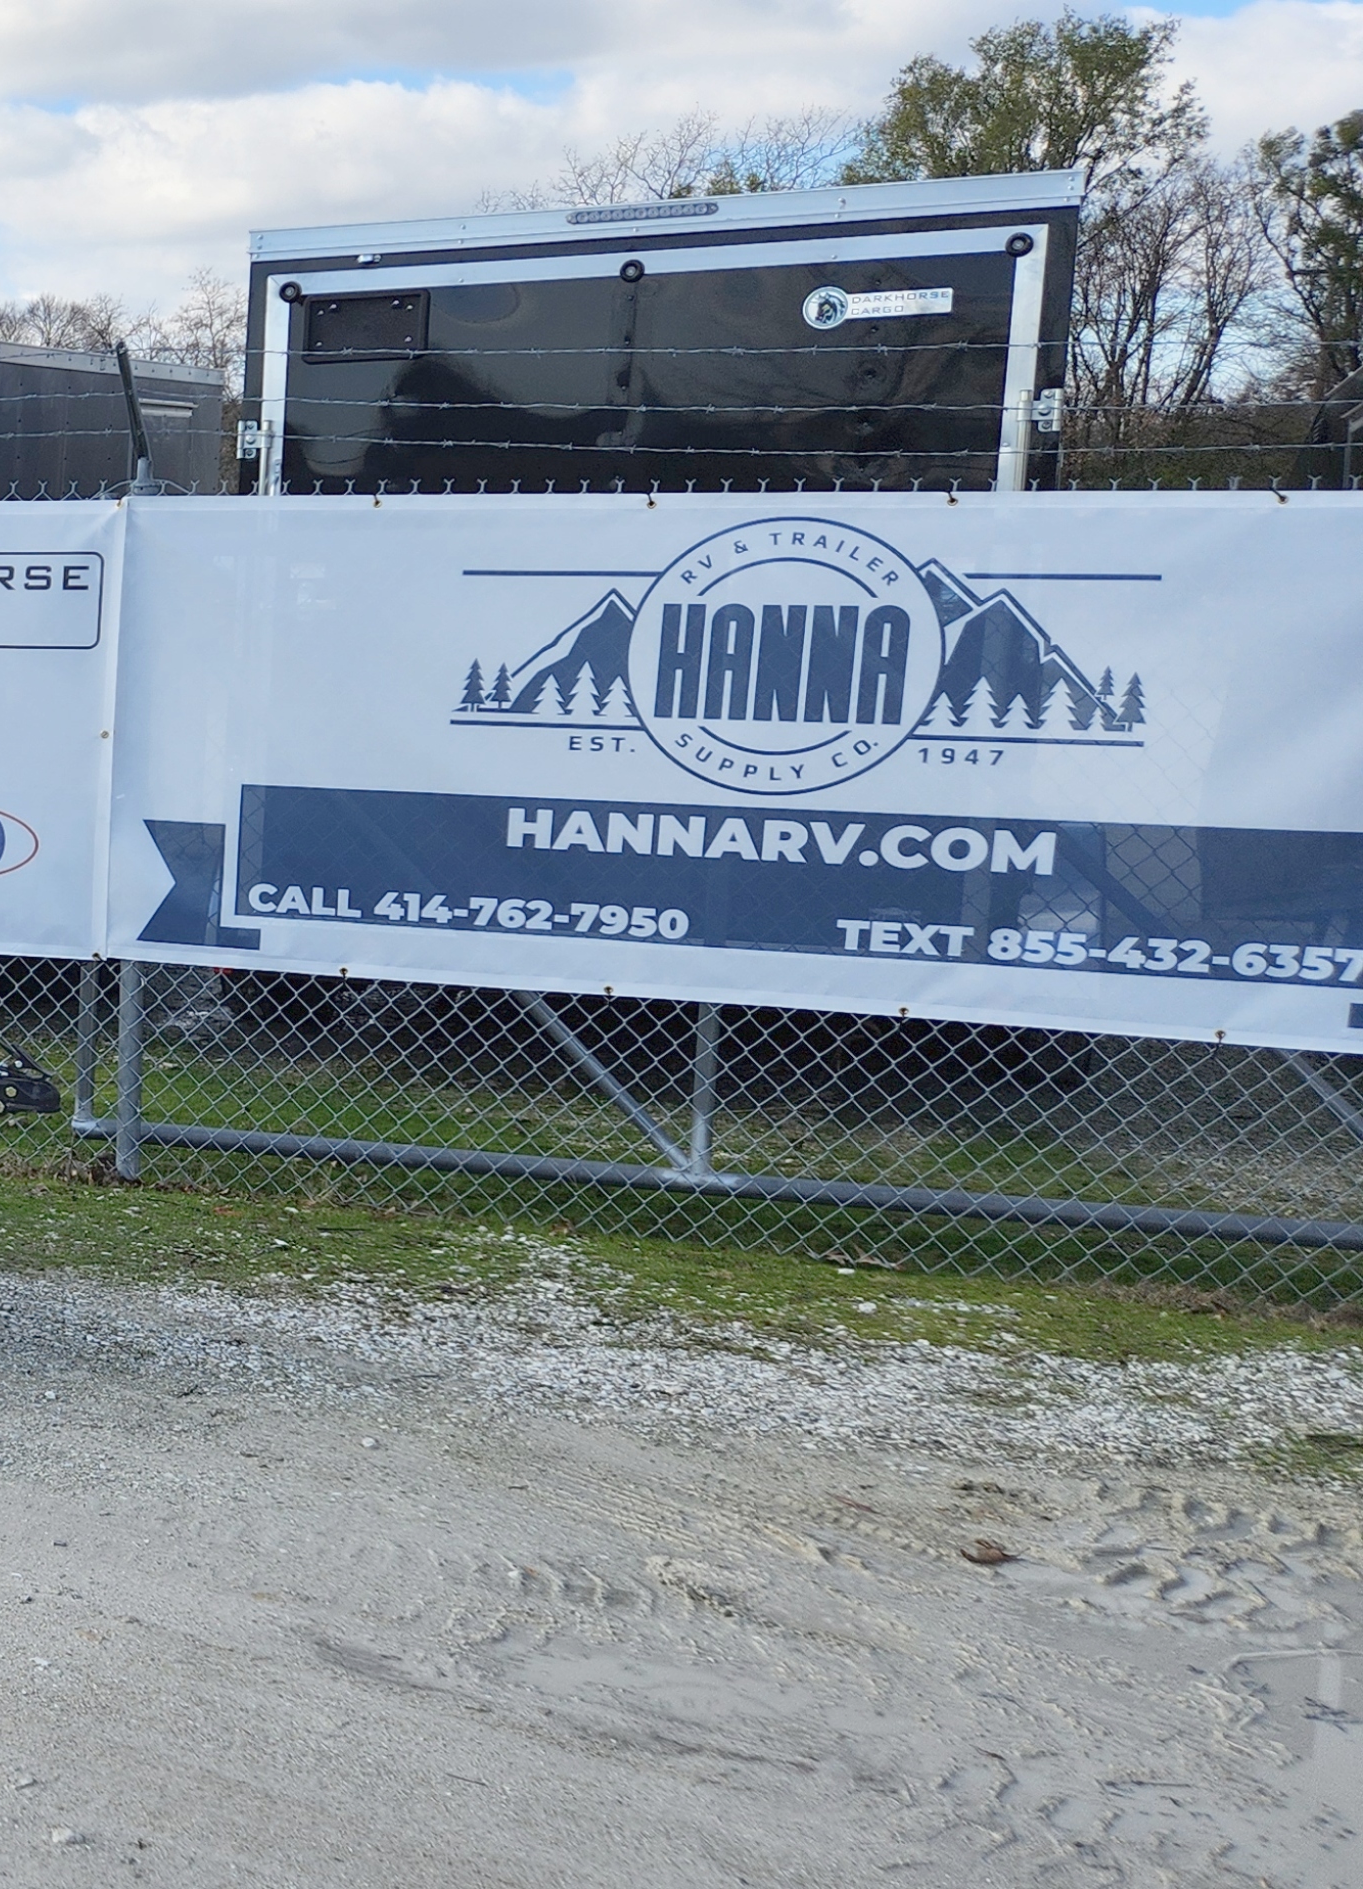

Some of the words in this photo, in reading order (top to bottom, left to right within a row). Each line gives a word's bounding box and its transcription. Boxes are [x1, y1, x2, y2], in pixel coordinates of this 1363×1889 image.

[851, 305, 904, 315] CARGO
[852, 291, 949, 304] DARKHORSE
[680, 555, 713, 585] RV
[733, 540, 749, 554] &
[769, 532, 899, 586] TRAILER
[653, 603, 910, 725] HANNA
[568, 734, 636, 754] EST.
[675, 732, 805, 781] SUPPLY
[831, 738, 879, 768] CO.
[917, 747, 1004, 767] 1947
[506, 807, 1056, 876] HANNARV.COM
[248, 883, 361, 919] CALL
[373, 891, 690, 940] 414-762-7950
[836, 918, 975, 958] TEXT
[987, 927, 1363, 983] 855-432-6357
